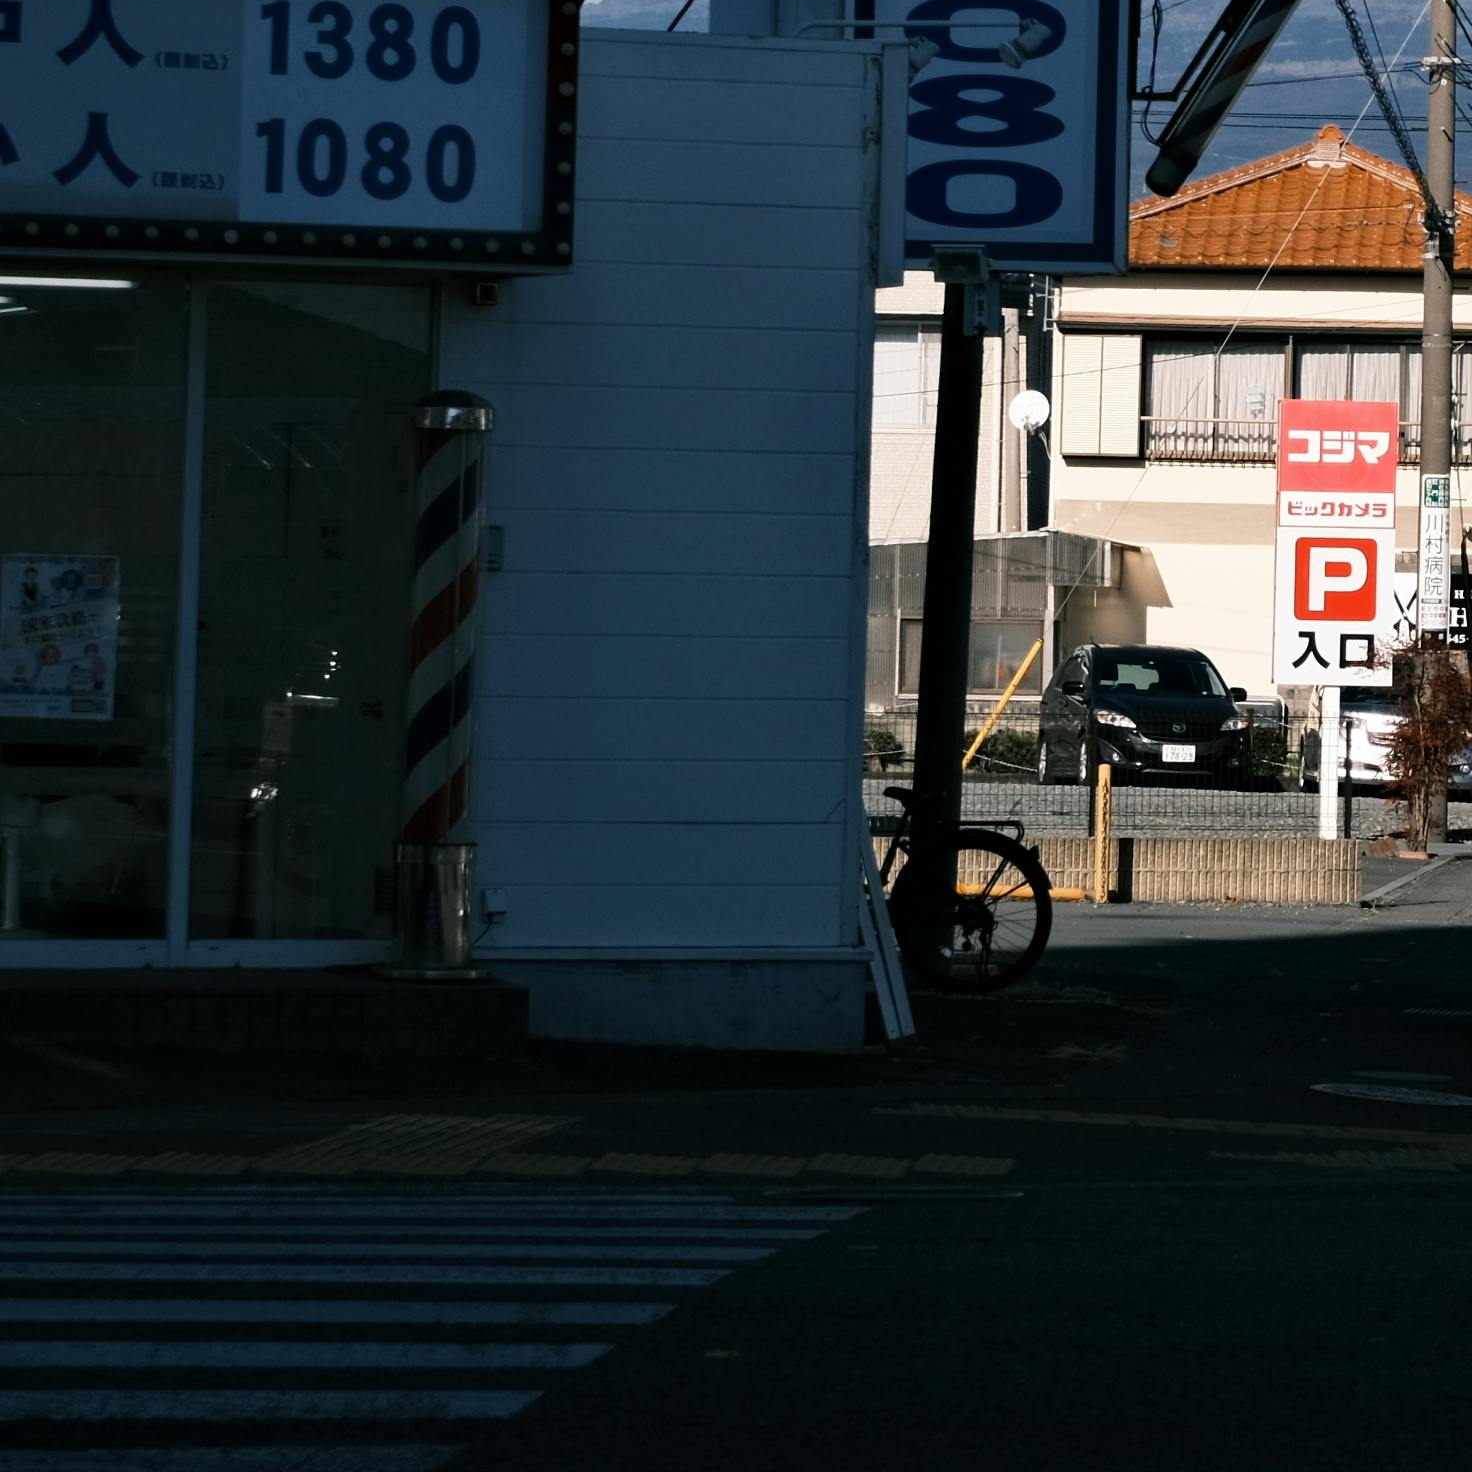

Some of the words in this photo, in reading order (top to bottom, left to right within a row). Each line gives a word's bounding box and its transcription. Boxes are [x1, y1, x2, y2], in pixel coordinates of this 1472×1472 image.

[260, 0, 482, 85] 1380
[255, 117, 477, 204] 1080
[1287, 429, 1390, 465] コジマ
[1287, 500, 1388, 518] ビックカメラ
[1308, 546, 1368, 612] P
[1424, 512, 1444, 596] 川村病院
[1292, 630, 1375, 669] 入口
